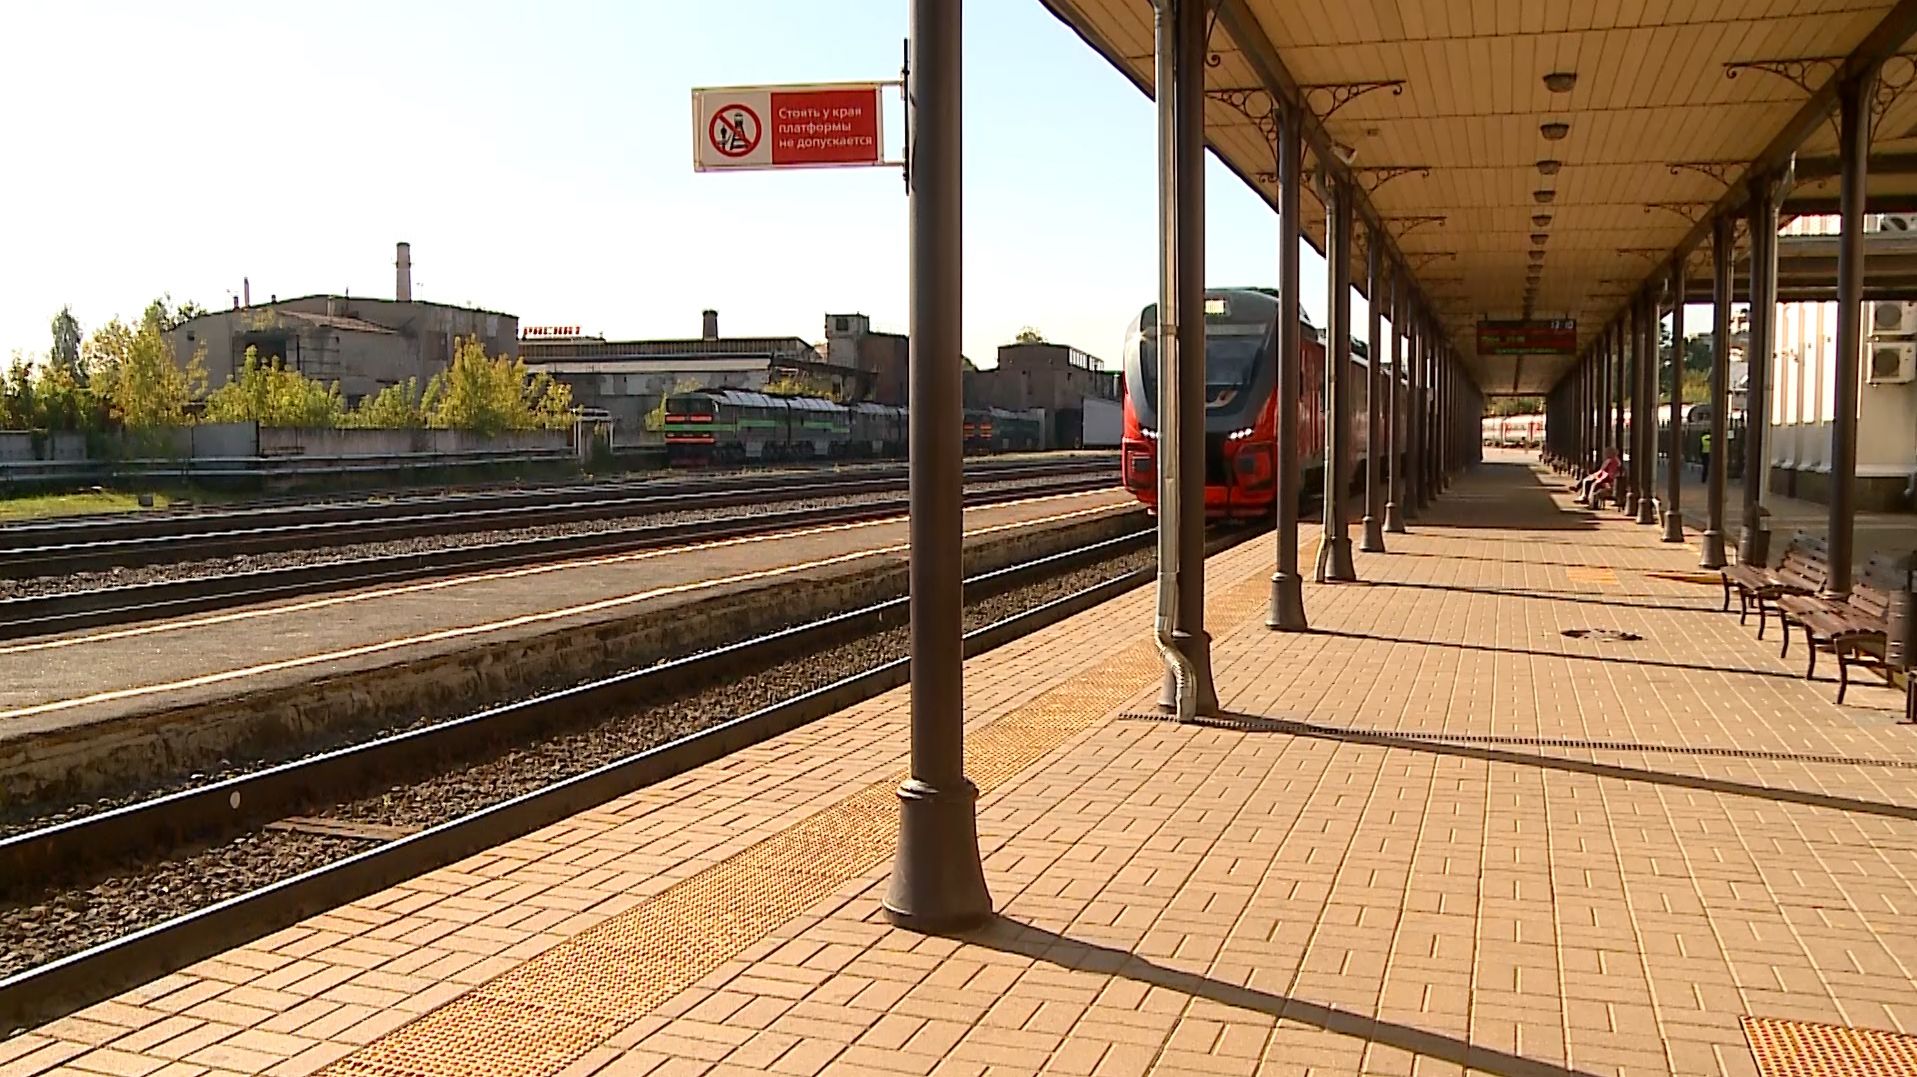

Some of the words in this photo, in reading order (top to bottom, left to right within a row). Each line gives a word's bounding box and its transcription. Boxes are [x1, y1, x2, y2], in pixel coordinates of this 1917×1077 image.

[778, 108, 820, 119] Стоять
[822, 109, 830, 120] у
[832, 108, 861, 118] края
[778, 122, 851, 135] платформы
[779, 138, 794, 148] не
[796, 136, 872, 149] допускается
